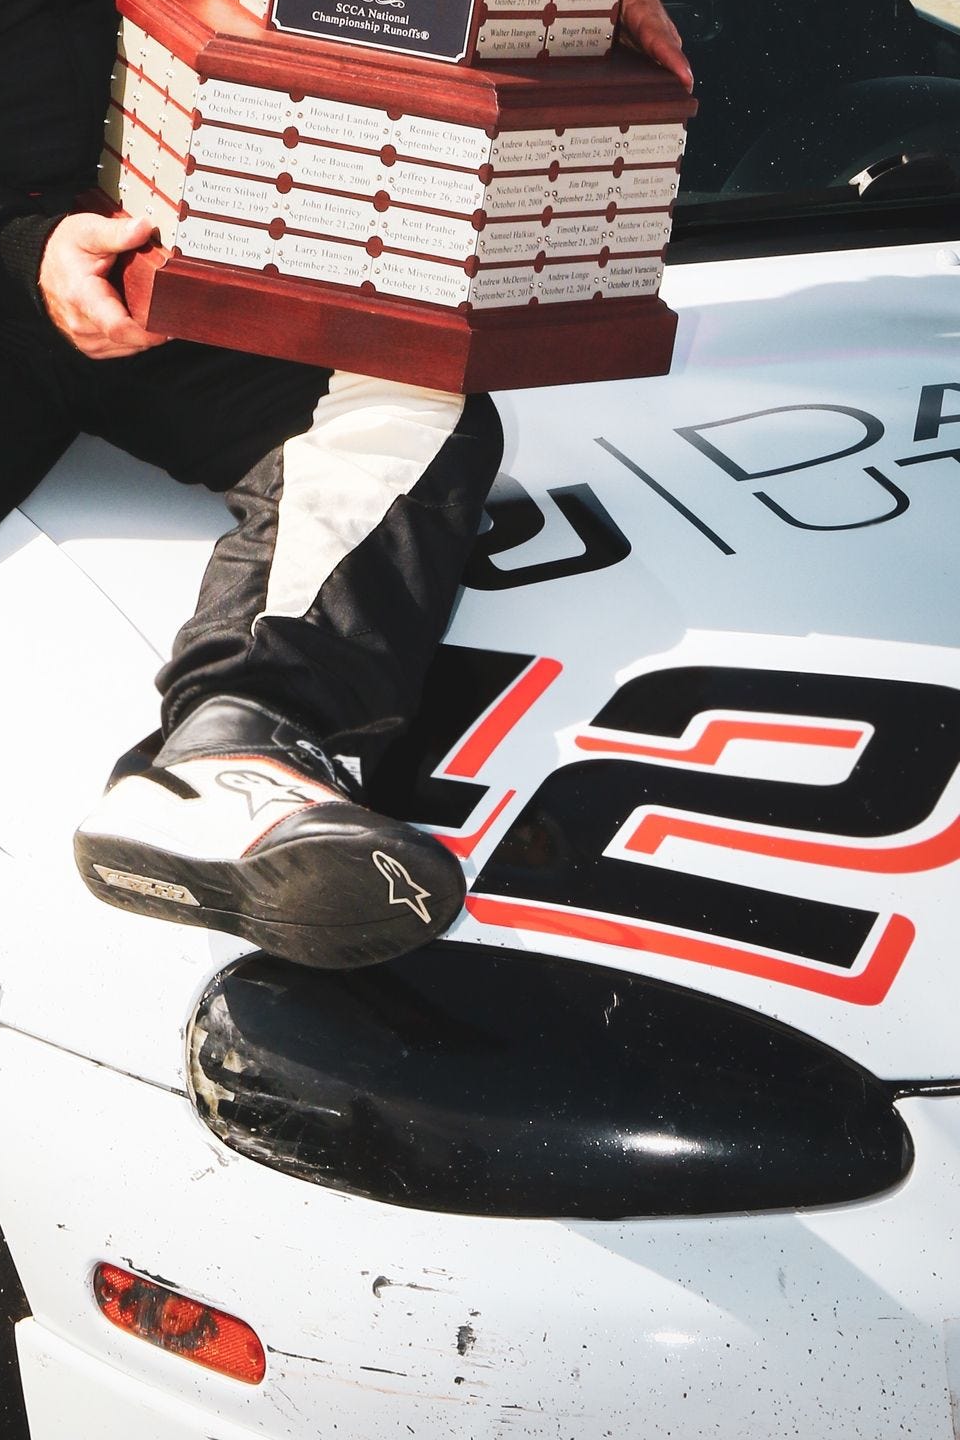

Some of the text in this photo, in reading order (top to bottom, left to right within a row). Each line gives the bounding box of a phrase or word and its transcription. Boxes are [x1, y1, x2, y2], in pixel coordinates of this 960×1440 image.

[336, 3, 410, 25] SCCA National
[312, 11, 380, 33] Championship
[213, 90, 282, 109] Dan Carmichael
[208, 103, 241, 116] October
[310, 107, 379, 128] Howard Landon
[305, 121, 339, 134] October
[409, 125, 476, 145] Rennie Clayton
[217, 137, 263, 153] Bruce May
[202, 150, 235, 162] October
[312, 154, 326, 164] Joe
[301, 167, 336, 180] October
[399, 171, 474, 192] Jeffrey Loughead
[202, 181, 268, 199] Warren Stilwell
[391, 184, 436, 199] September
[195, 194, 229, 206] October
[301, 198, 322, 209] John
[289, 211, 333, 226] September
[401, 218, 456, 236] Kent Prather
[204, 229, 249, 244] Brad Stout
[384, 230, 429, 246] September
[188, 241, 222, 254] October
[295, 245, 353, 262] Larry Hansen
[382, 263, 461, 284] Mike Miserendino
[382, 278, 416, 291] October
